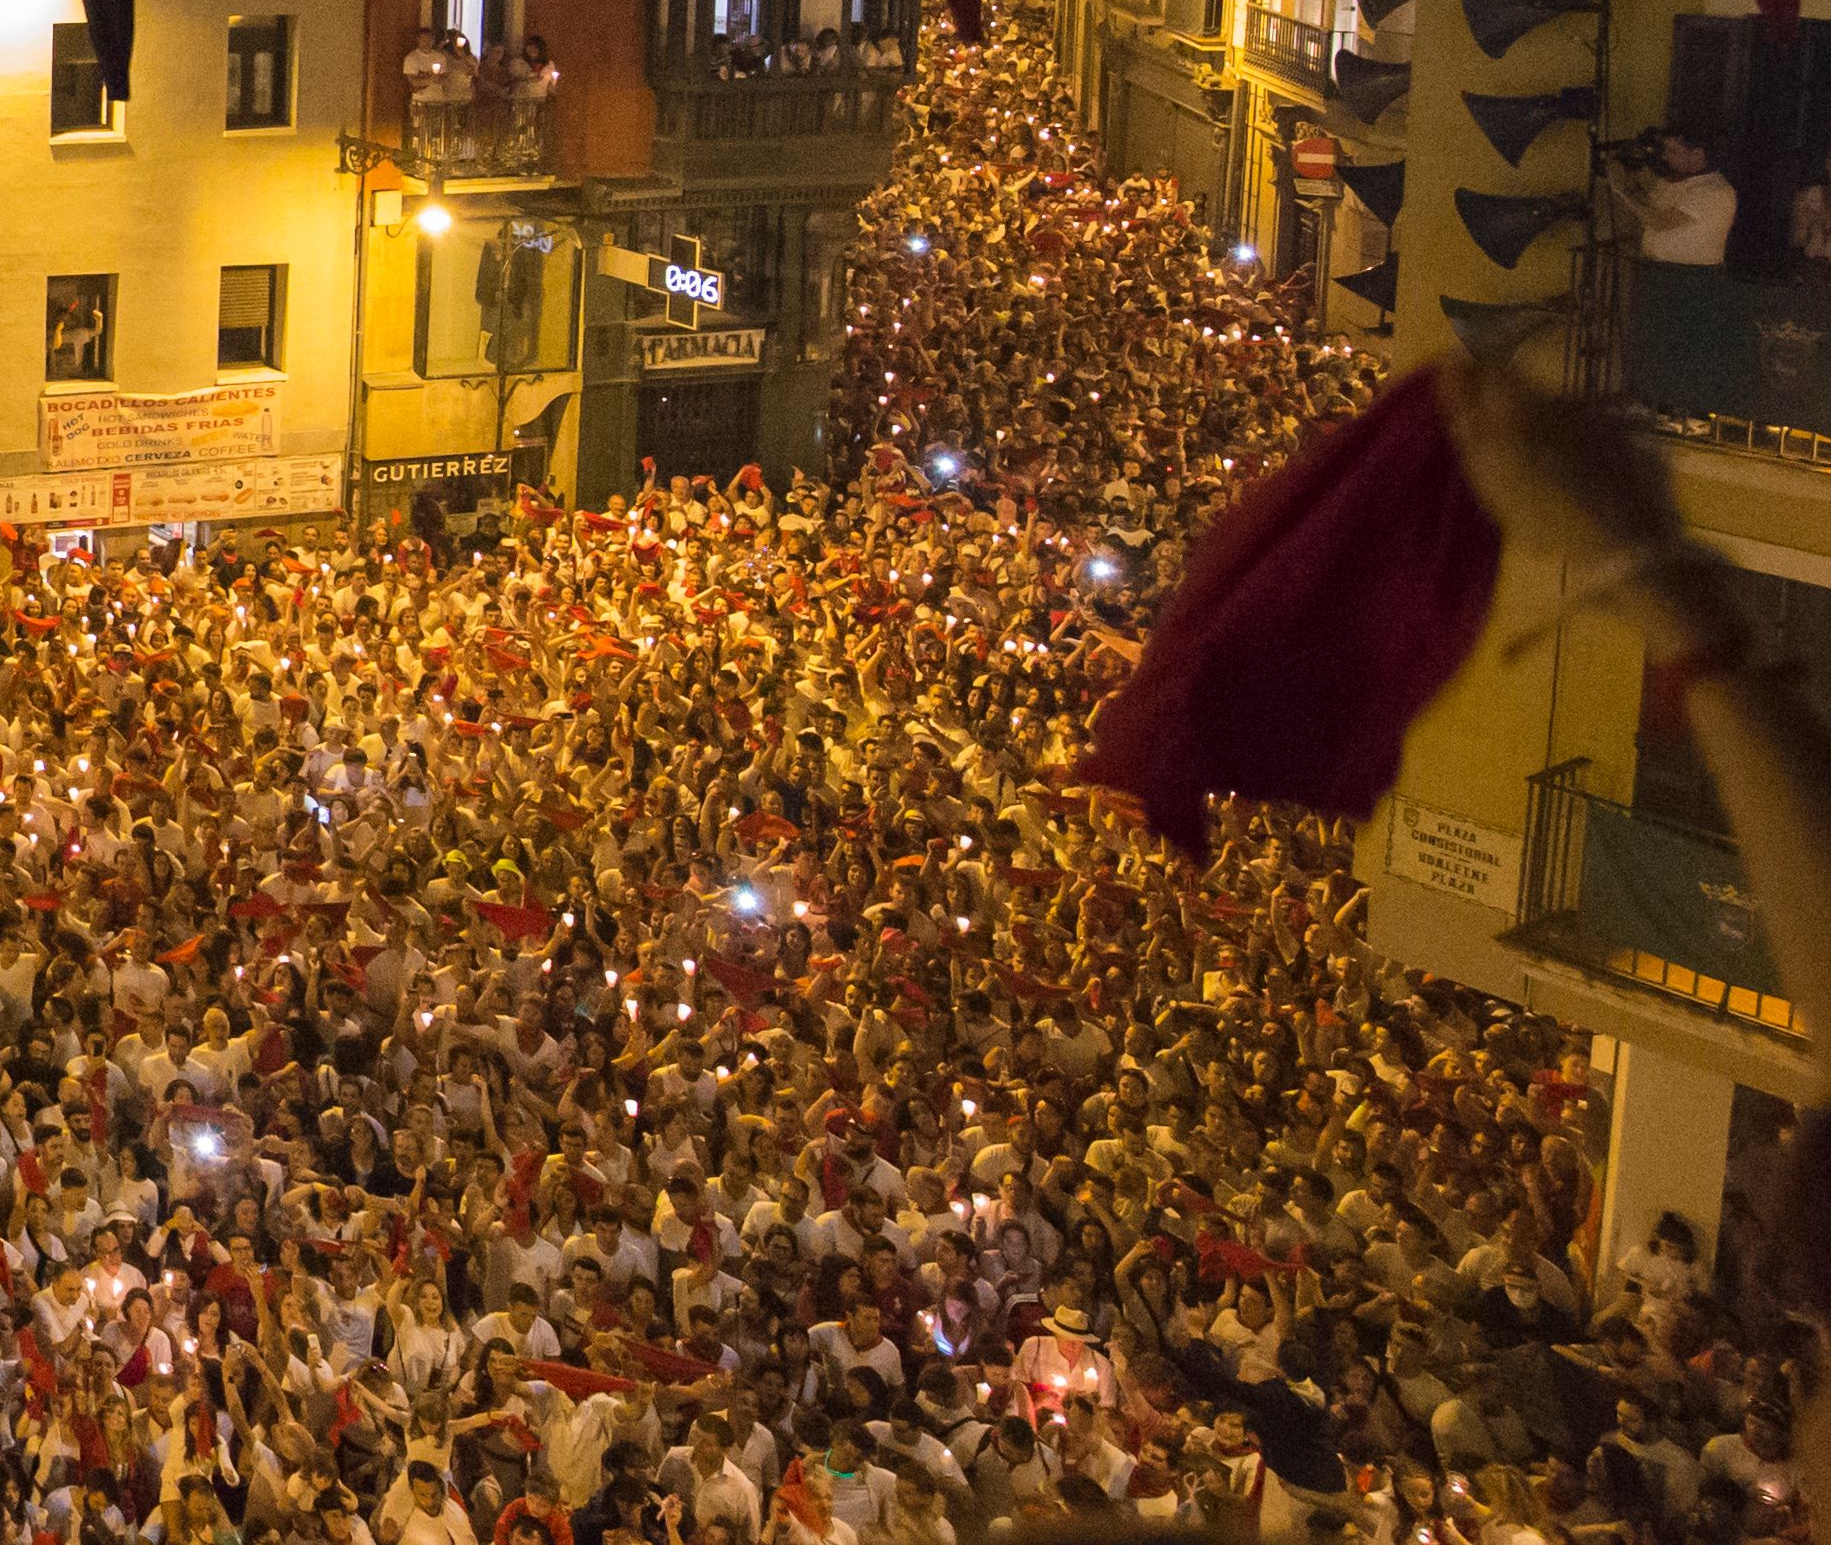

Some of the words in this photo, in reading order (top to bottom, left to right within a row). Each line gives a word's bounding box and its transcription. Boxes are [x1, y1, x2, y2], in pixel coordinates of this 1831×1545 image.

[665, 265, 719, 303] 0:06
[47, 397, 173, 413] BOCADILLOS
[175, 387, 276, 405] CALIENTES
[62, 413, 85, 431] HOT
[91, 422, 178, 437] BEBIDAS
[187, 417, 244, 430] FRIAS
[125, 450, 191, 463] CERVEZA
[198, 444, 256, 457] COFFEE
[373, 457, 508, 483] GUTIERREZ
[1438, 822, 1476, 843] PLAZA
[1411, 830, 1502, 867] CONSISTORIAL
[1431, 871, 1475, 894] PLAZA
